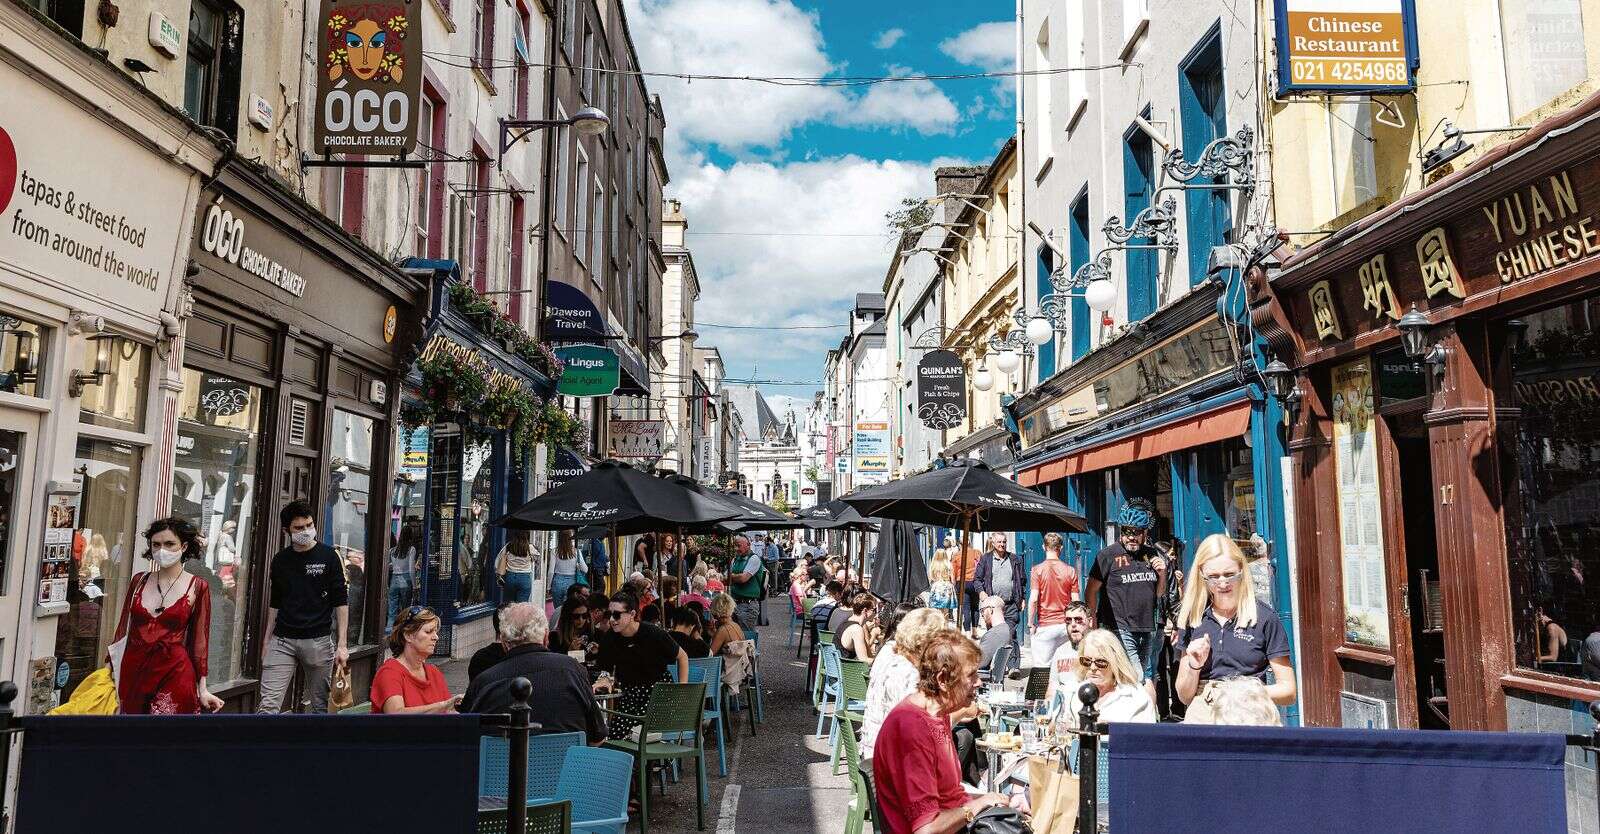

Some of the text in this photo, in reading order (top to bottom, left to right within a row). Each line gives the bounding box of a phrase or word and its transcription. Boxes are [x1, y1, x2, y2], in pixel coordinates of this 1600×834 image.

[161, 19, 180, 44] ERIN
[1308, 16, 1383, 33] Chinese
[1294, 36, 1400, 52] Restaurant
[1294, 61, 1407, 81] 021 4254968
[325, 78, 409, 132] ÓCO
[324, 136, 407, 146] CHOCOLATE BAKERY
[20, 170, 147, 249] tapas & street food
[1483, 170, 1579, 243] YUAN
[12, 209, 160, 292] from around the world
[202, 194, 307, 298] ÓCO CHOCOLATE BAKERY
[1495, 217, 1600, 283] CHINESE
[551, 307, 592, 317] Dawson
[555, 319, 586, 329] Travel
[571, 358, 604, 369] Lingus
[921, 366, 963, 375] QUINLAN'S
[549, 467, 584, 476] awson
[1440, 484, 1454, 505] 17
[552, 508, 619, 519] FEVER-TREE
